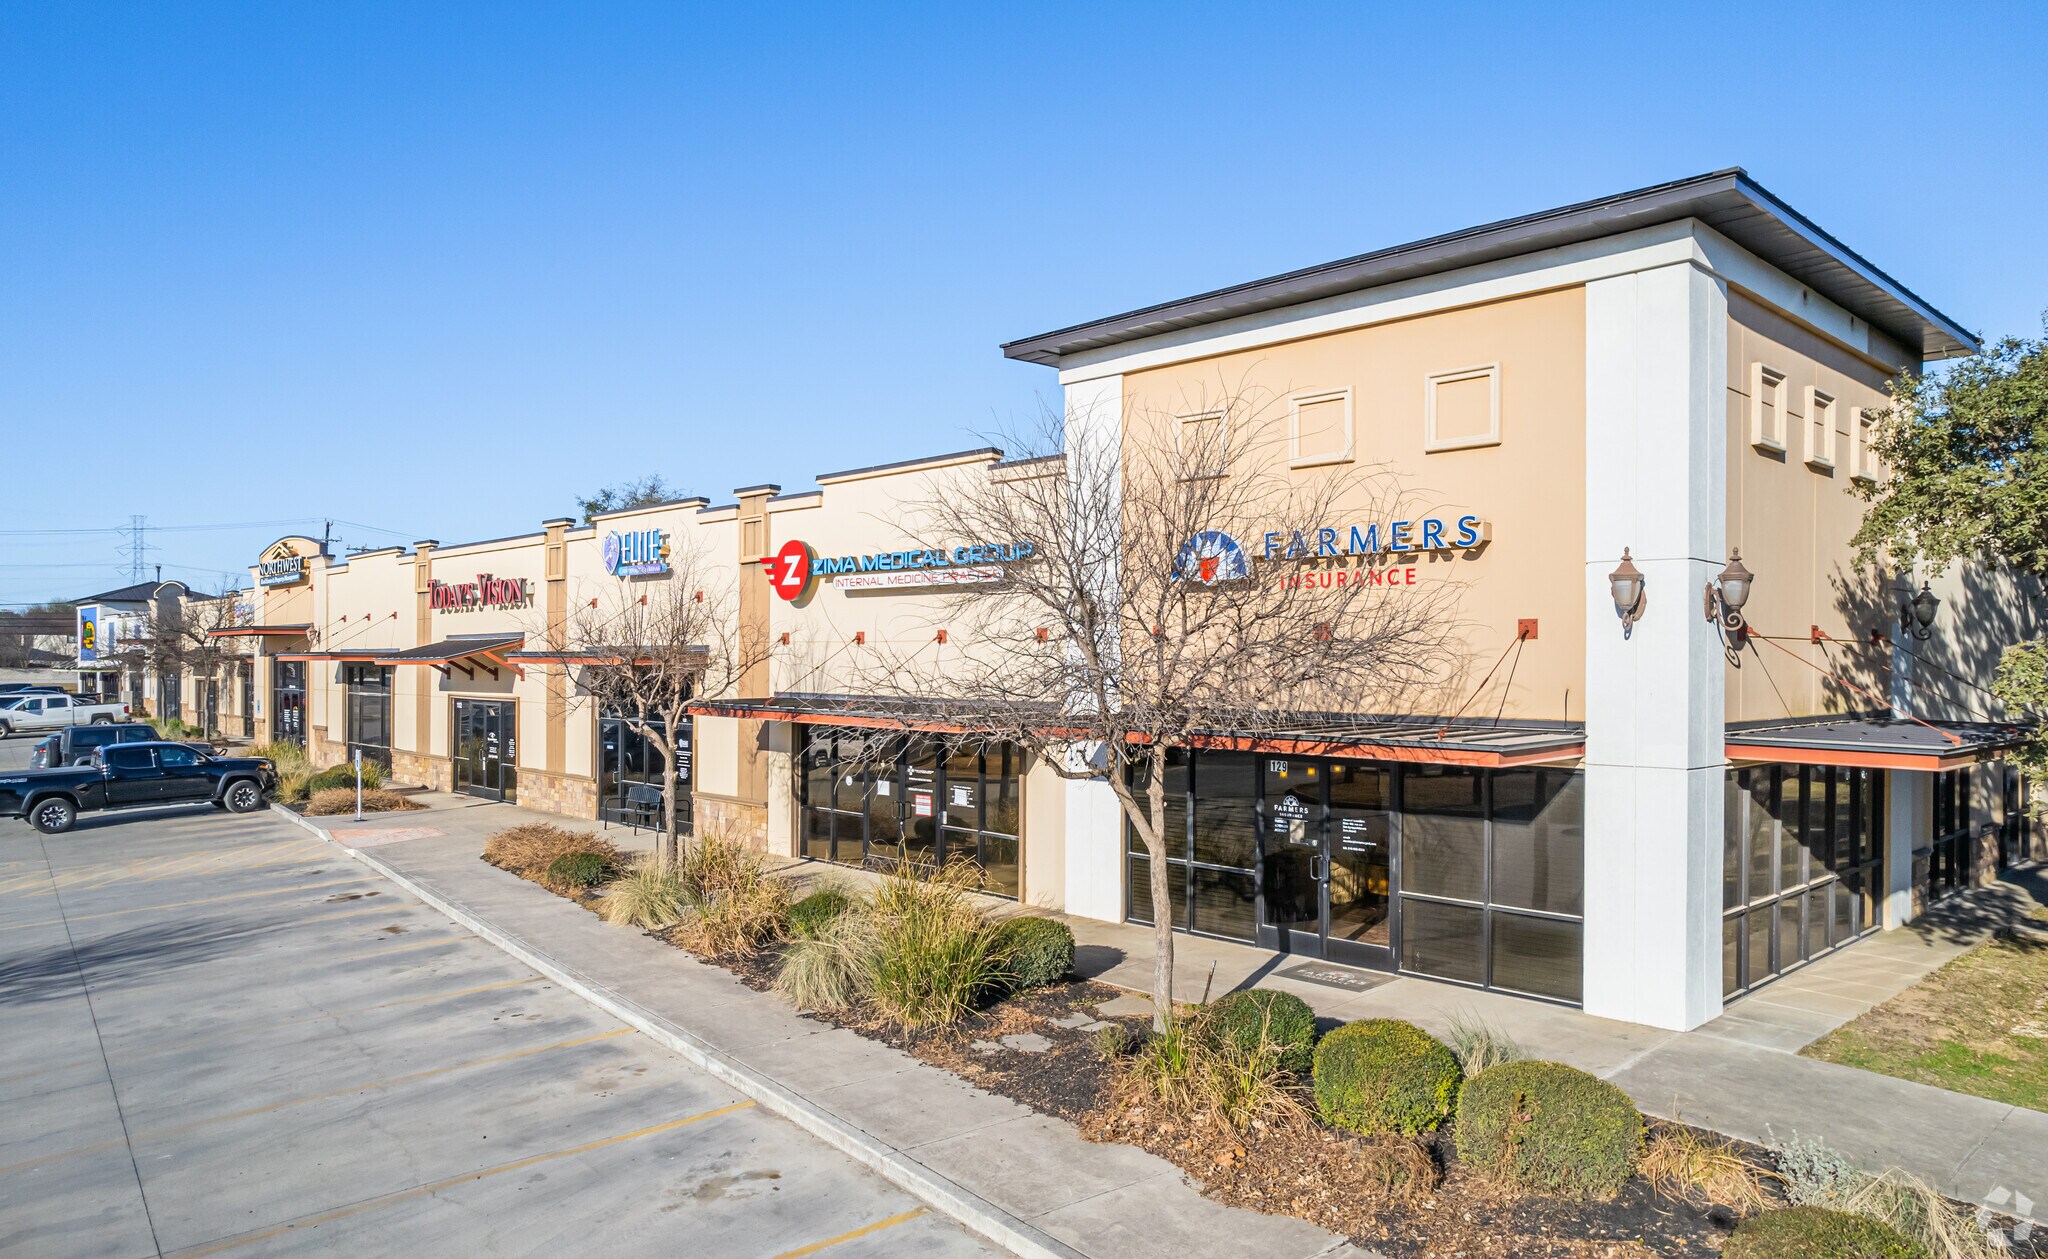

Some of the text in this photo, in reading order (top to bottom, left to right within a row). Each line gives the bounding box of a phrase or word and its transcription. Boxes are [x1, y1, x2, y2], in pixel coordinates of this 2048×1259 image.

[621, 528, 659, 564] ELITE
[1263, 515, 1480, 560] FARMERS
[259, 556, 302, 576] NORTHWEST
[782, 555, 801, 585] Z
[812, 541, 1033, 576] ZIMA MEDICAL GROUP
[427, 573, 522, 609] TODAY'S VISION
[834, 577, 883, 587] INTERNAL
[887, 573, 938, 584] MEDICINE
[1280, 568, 1416, 590] INSURANCE
[1271, 760, 1287, 772] 129
[1274, 804, 1309, 815] FARMERS
